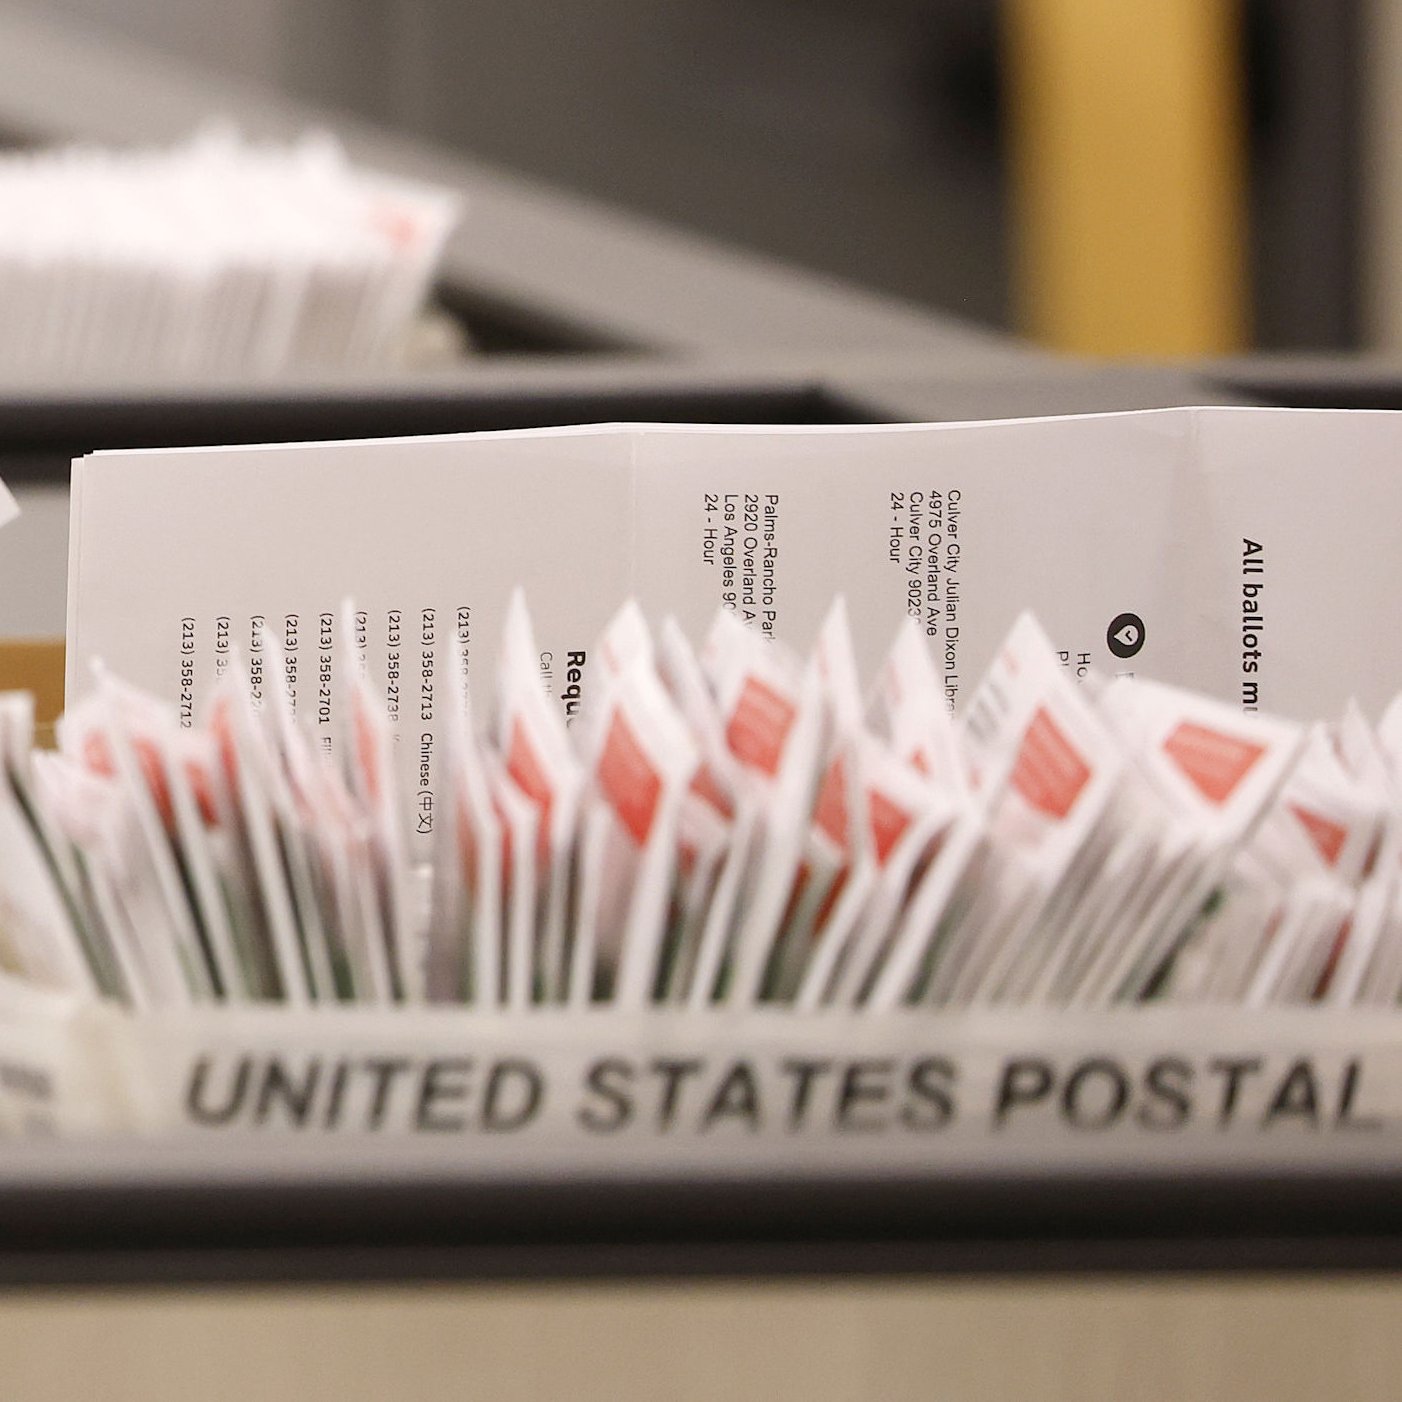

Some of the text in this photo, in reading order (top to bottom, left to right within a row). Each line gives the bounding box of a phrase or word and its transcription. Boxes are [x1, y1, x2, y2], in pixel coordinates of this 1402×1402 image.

[703, 493, 717, 512] 24
[724, 494, 738, 521] Los
[744, 494, 758, 532] 2920
[890, 492, 903, 510] 24
[946, 489, 960, 538] Culver
[702, 528, 716, 564] Hour
[720, 526, 737, 586] Angeles
[761, 494, 778, 604] Palms-Rancho
[888, 526, 902, 563] Hour
[905, 491, 922, 624] Culver City 9023
[926, 490, 941, 636] 4975 Overland Ave
[943, 543, 960, 572] City
[1242, 538, 1263, 574] All
[742, 536, 756, 604] Overland
[944, 577, 958, 622] Julian
[214, 616, 230, 654] (213)
[248, 615, 264, 652] (213)
[283, 614, 298, 652] (213)
[386, 610, 401, 647] (213)
[456, 606, 470, 644] (213)
[1242, 583, 1263, 673] ballots
[538, 652, 552, 678] Call
[944, 626, 958, 670] Dixon
[179, 618, 195, 729] (213) 358-2712
[318, 612, 334, 725] (213) 358-2701
[1076, 652, 1091, 684] Ho
[416, 608, 436, 834] (213) 358-2713 Chinese (中文)
[184, 1054, 1386, 1133] UNITED STATES POSTAL
